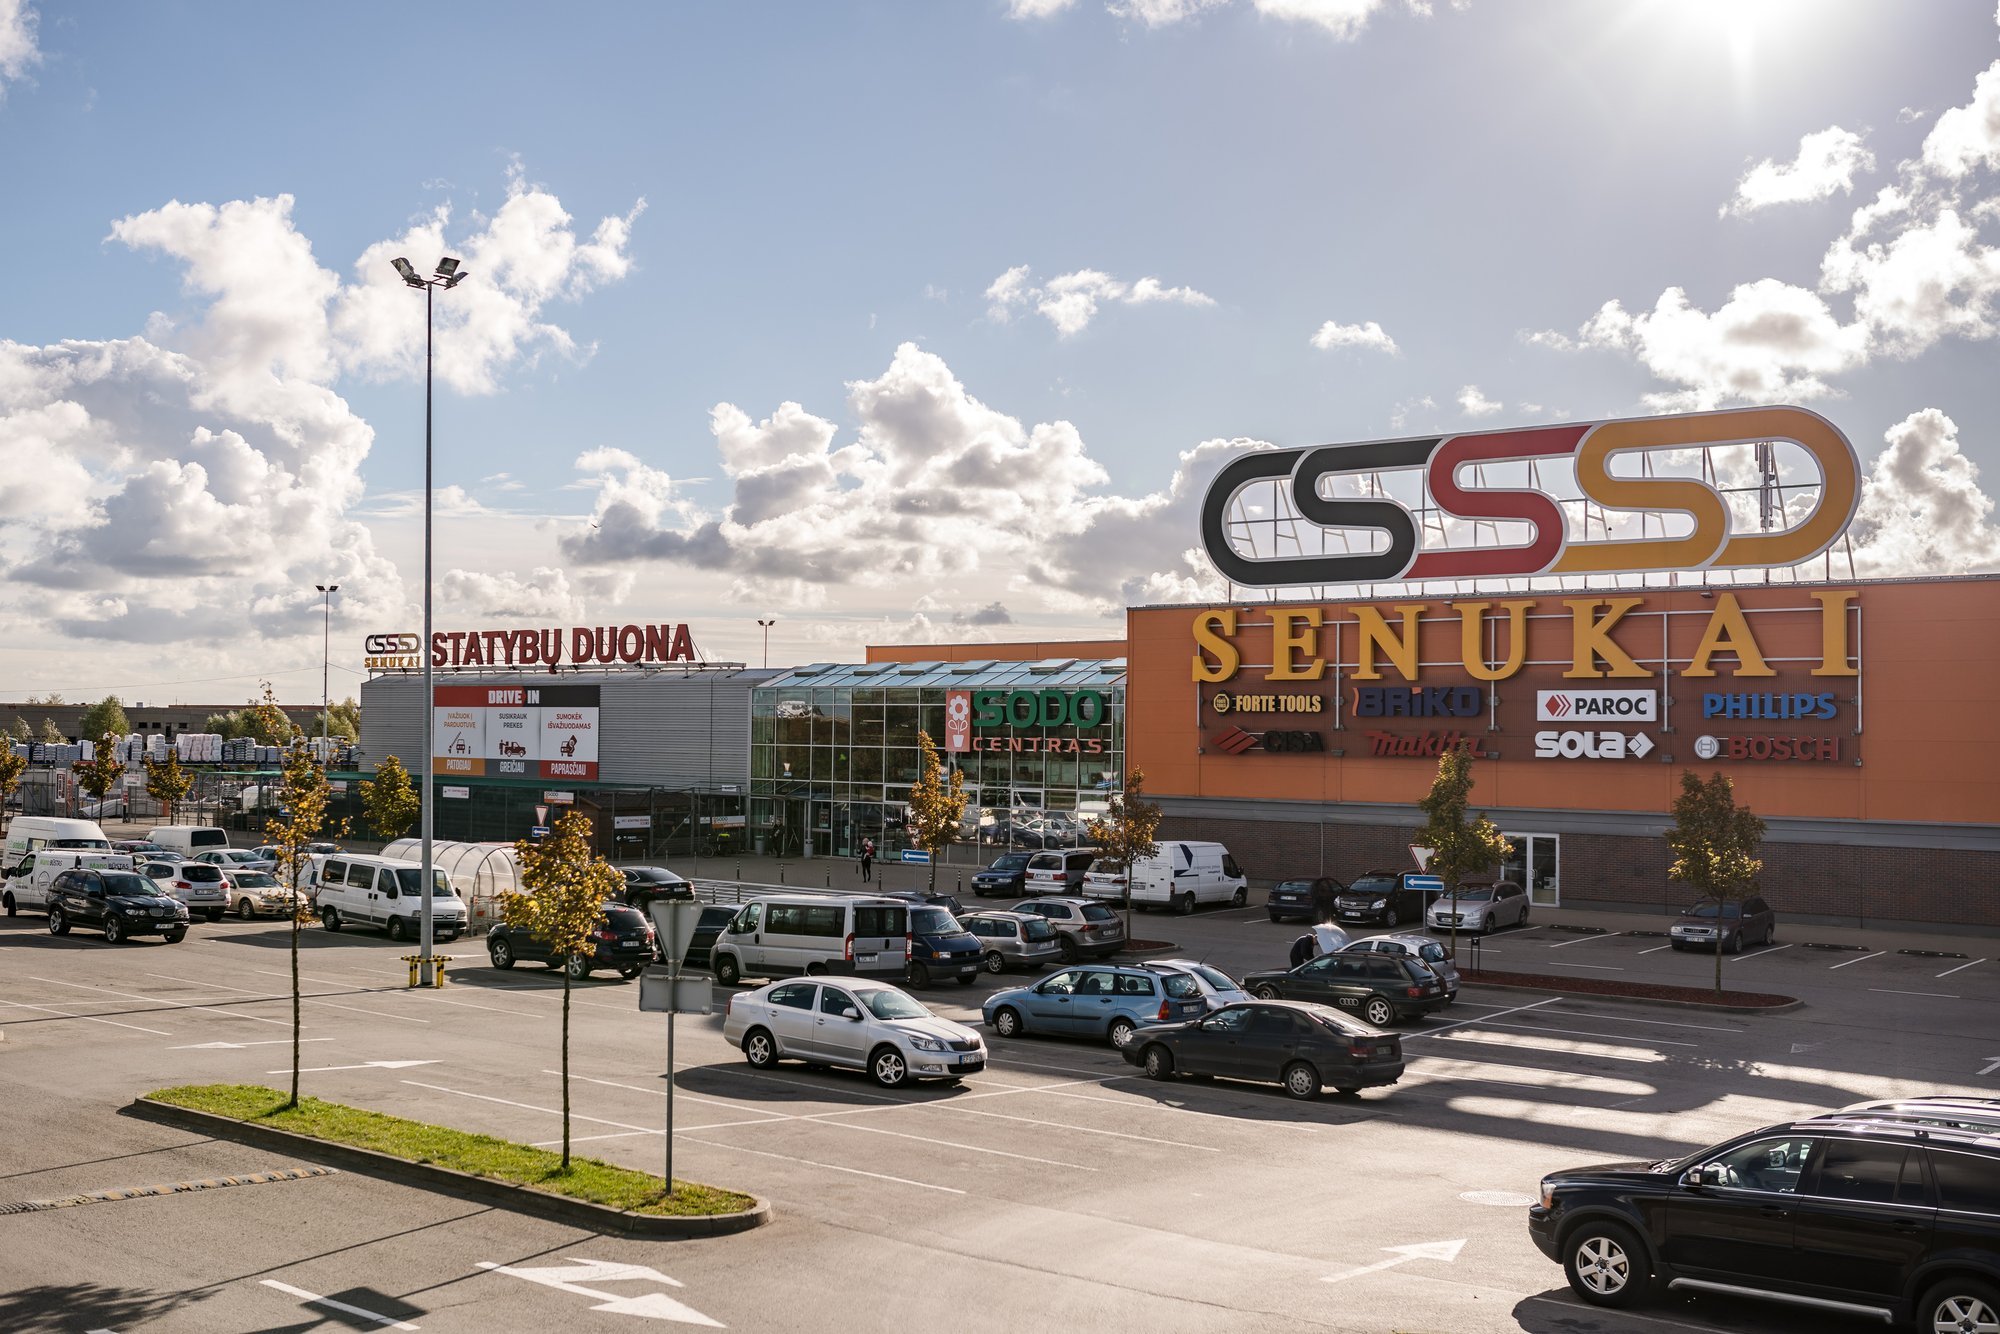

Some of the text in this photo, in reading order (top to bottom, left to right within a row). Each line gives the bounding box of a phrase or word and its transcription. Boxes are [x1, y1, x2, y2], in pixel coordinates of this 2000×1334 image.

[1191, 591, 1860, 682] SENUKAI
[431, 623, 695, 674] STATYBŲ DUONA
[364, 656, 421, 668] SENUKAI
[488, 690, 540, 704] DRIVE IN
[1235, 695, 1275, 713] FORTE
[1279, 695, 1322, 713] TOOLS
[973, 690, 1103, 729] SODO
[1574, 697, 1648, 716] PAROC
[1703, 692, 1838, 720] PHILIPS
[498, 712, 528, 720] SUSIKRAUK
[556, 712, 582, 720] SUMOKĖK
[547, 721, 592, 730] IŠVAŽIUODAMAS
[972, 737, 1102, 754] CENTRAS
[1727, 736, 1839, 762] BOSCH
[446, 759, 471, 771] PATOGIAU
[499, 759, 525, 773] GREIČIAU
[550, 761, 587, 776] PAPRASČIAU
